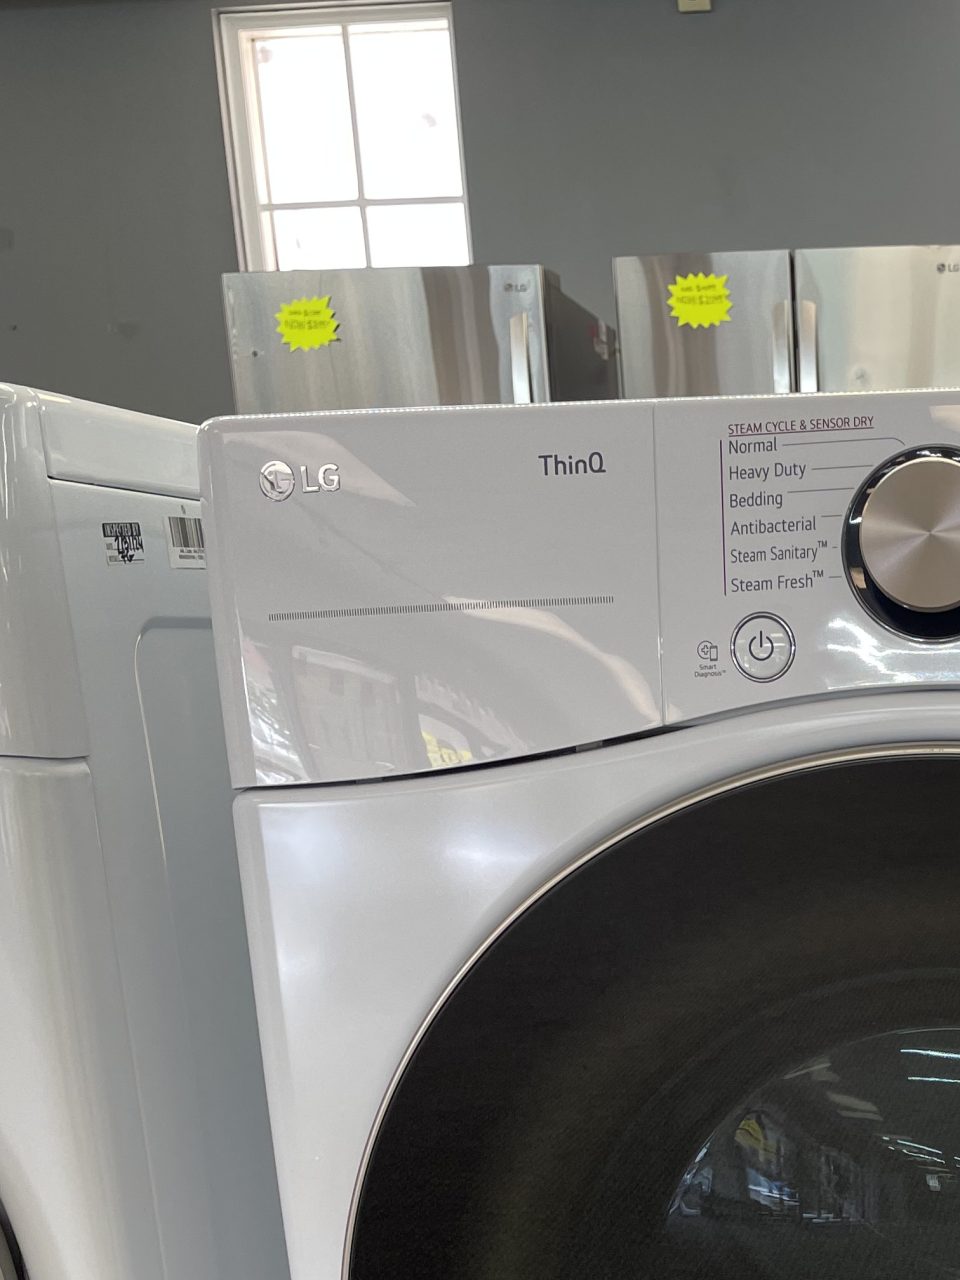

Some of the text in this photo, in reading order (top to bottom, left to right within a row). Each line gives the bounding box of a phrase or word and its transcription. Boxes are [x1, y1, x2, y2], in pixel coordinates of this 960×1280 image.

[728, 415, 874, 435] STEAM CYCLE & SENSOR DRY
[728, 436, 778, 455] Normal
[537, 451, 607, 476] ThinQ
[728, 462, 807, 482] Heavy Duty
[300, 463, 340, 493] LG
[729, 491, 784, 509] Bedding
[730, 516, 817, 536] Antibacterial
[730, 548, 767, 564] Steam
[731, 577, 773, 593] Steam
